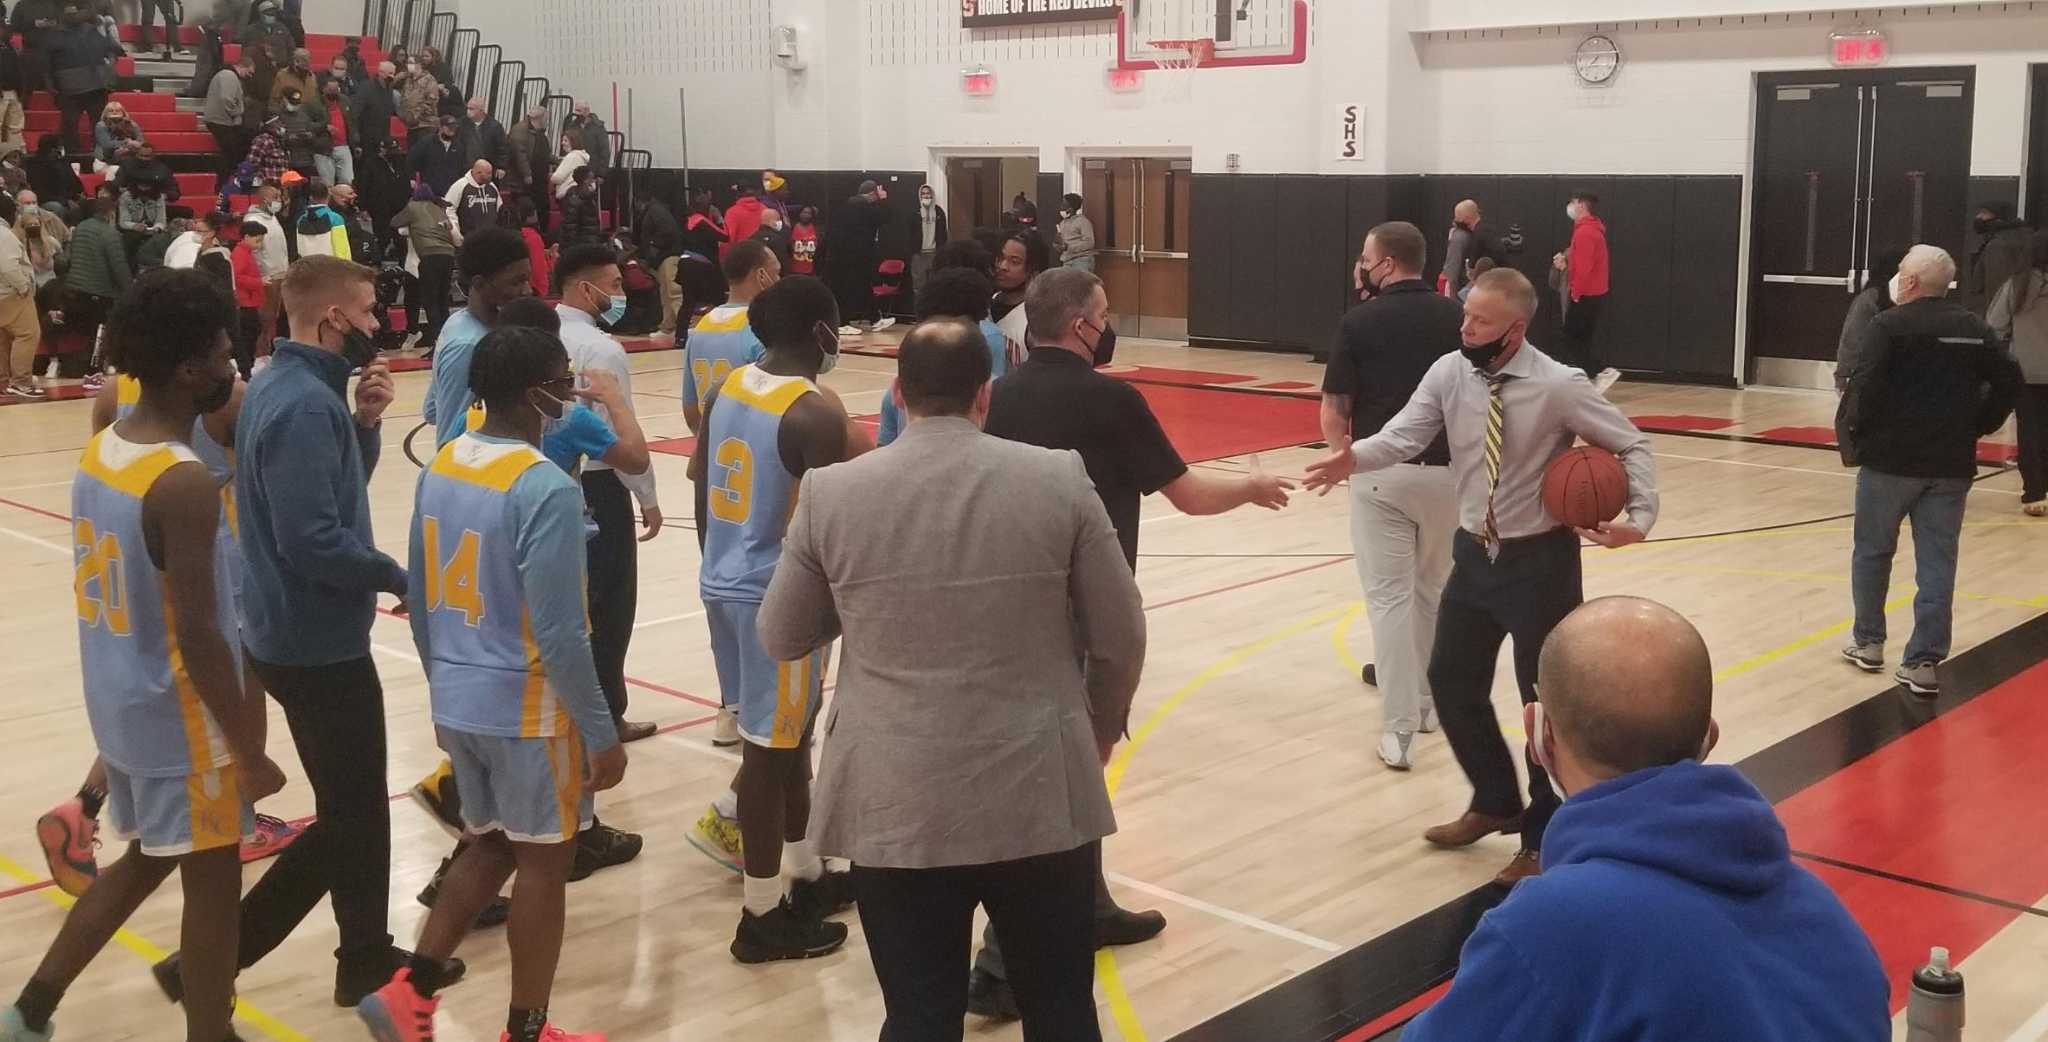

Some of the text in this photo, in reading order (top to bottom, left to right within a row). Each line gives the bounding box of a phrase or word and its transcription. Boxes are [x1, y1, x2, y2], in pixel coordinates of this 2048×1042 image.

[978, 0, 1009, 15] HOME
[1011, 0, 1024, 14] OF
[1027, 0, 1047, 12] THE
[1048, 0, 1071, 11] RED
[1073, 0, 1113, 9] DEVILS
[1342, 105, 1357, 157] SHS
[709, 437, 754, 526] 3
[75, 516, 132, 637] 20
[422, 514, 485, 629] 14
